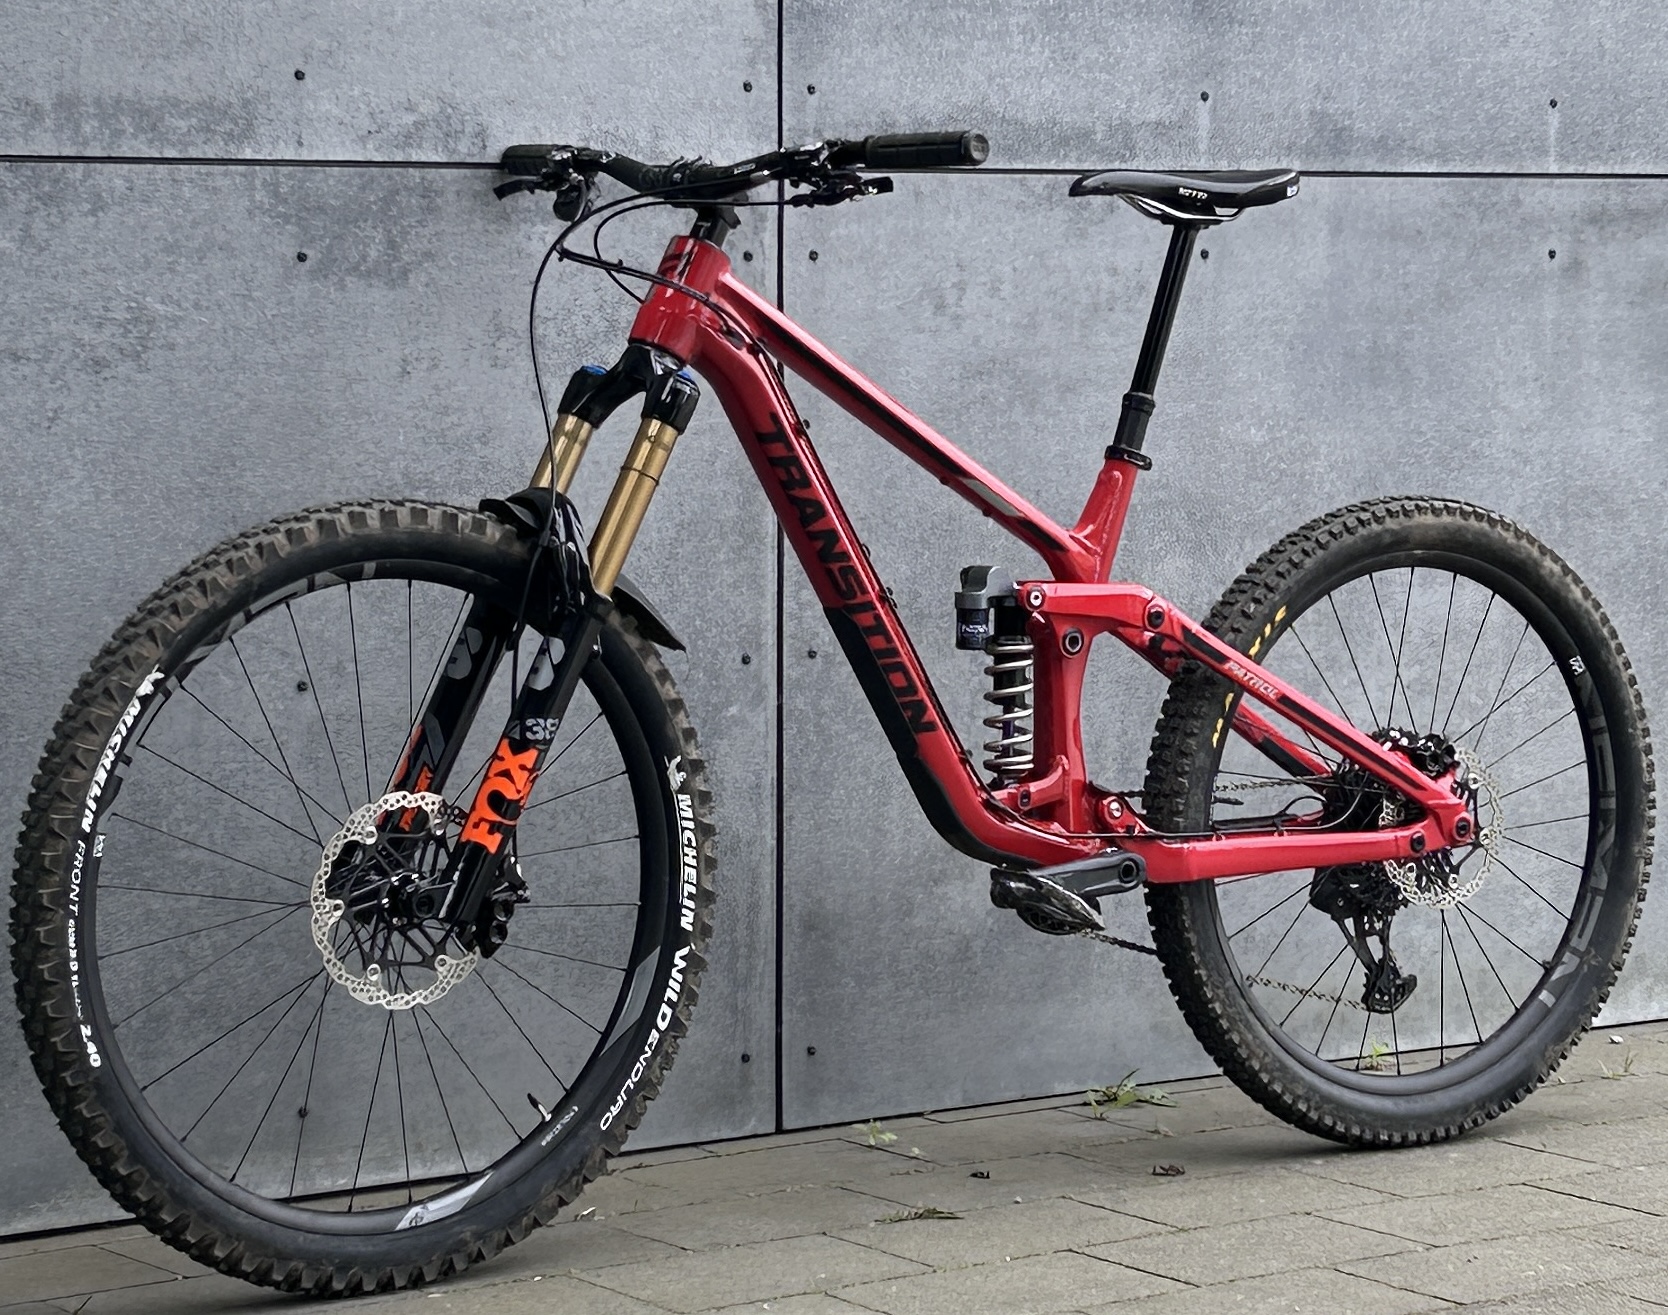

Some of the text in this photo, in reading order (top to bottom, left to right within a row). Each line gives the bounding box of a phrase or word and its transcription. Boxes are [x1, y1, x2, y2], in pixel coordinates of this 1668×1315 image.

[757, 411, 938, 735] TRANSITION
[81, 697, 142, 834] MICHELIN
[459, 737, 539, 855] FOX
[69, 839, 87, 917] FRONT
[600, 792, 698, 1131] MICHELIN WILD ENDURO
